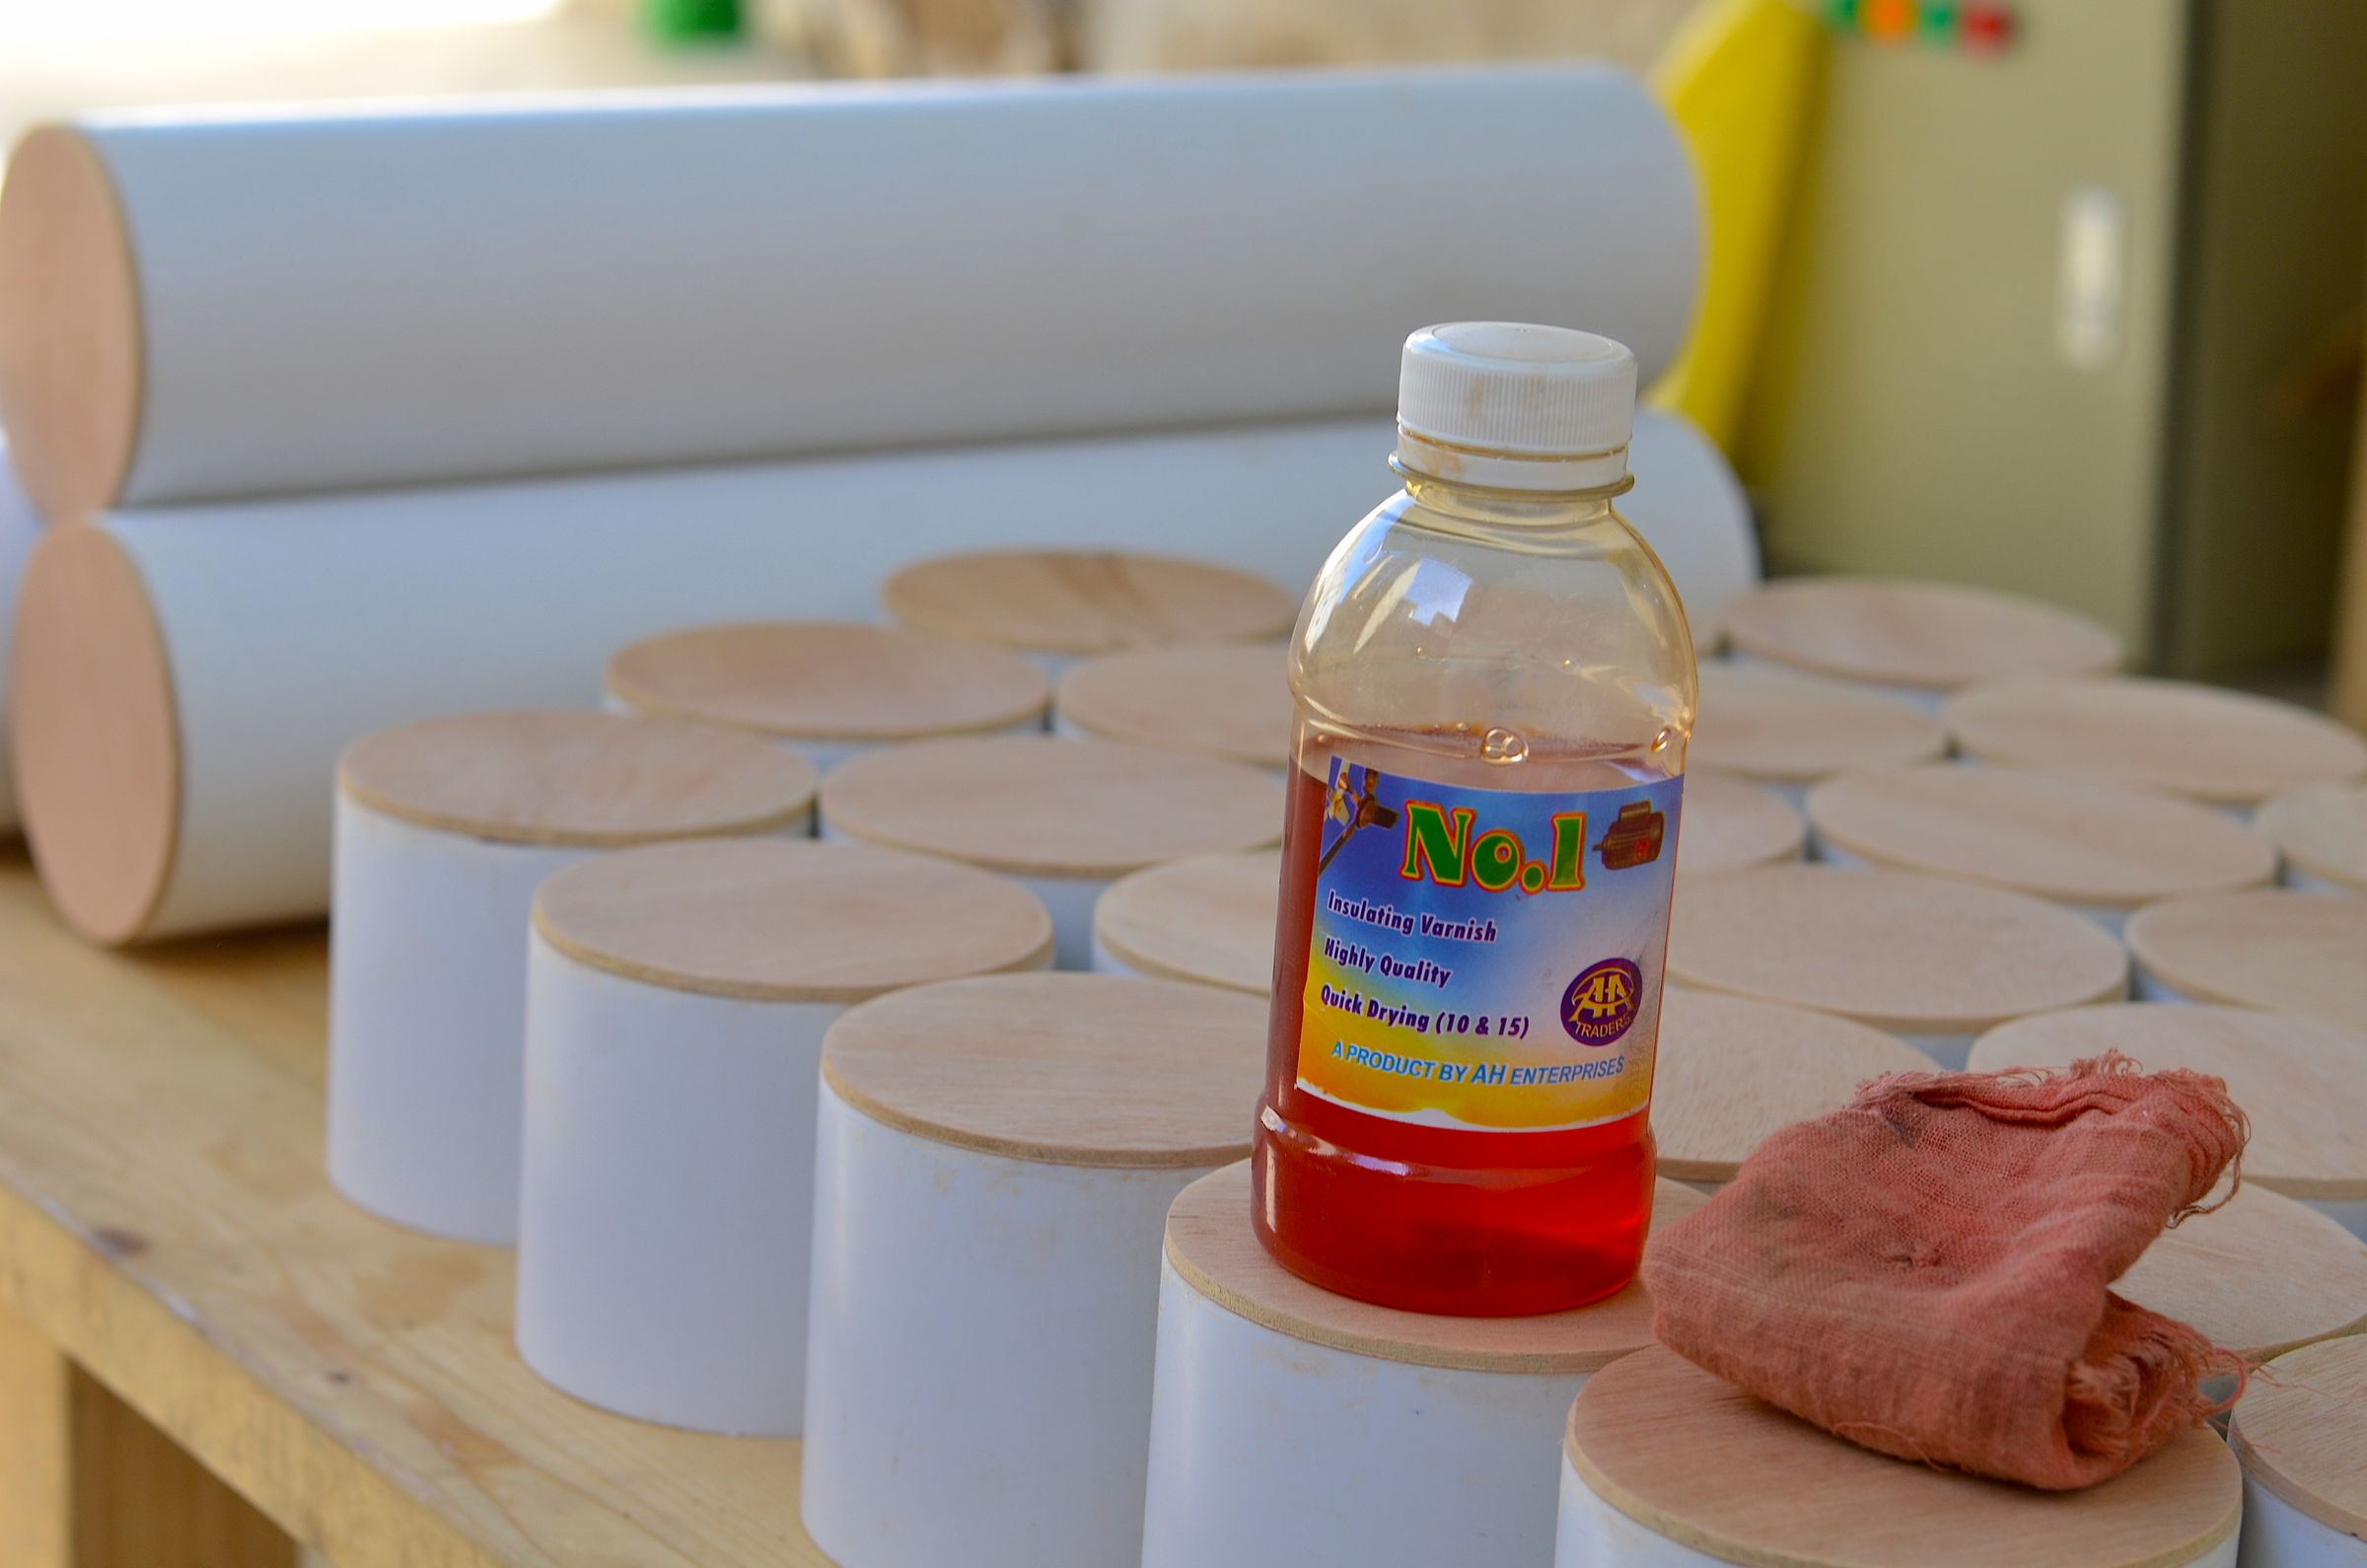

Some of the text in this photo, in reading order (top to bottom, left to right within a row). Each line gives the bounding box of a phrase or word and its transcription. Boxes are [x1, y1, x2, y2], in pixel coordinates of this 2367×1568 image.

[1399, 801, 1586, 893] No.1
[1327, 891, 1497, 943] Insulating Varnish
[1324, 937, 1452, 988] Highly Quality
[1320, 984, 1530, 1040] Quick Drying (10 & 15)
[1331, 1040, 1625, 1086] A PRODUCT BY AH ENTERPRISES
